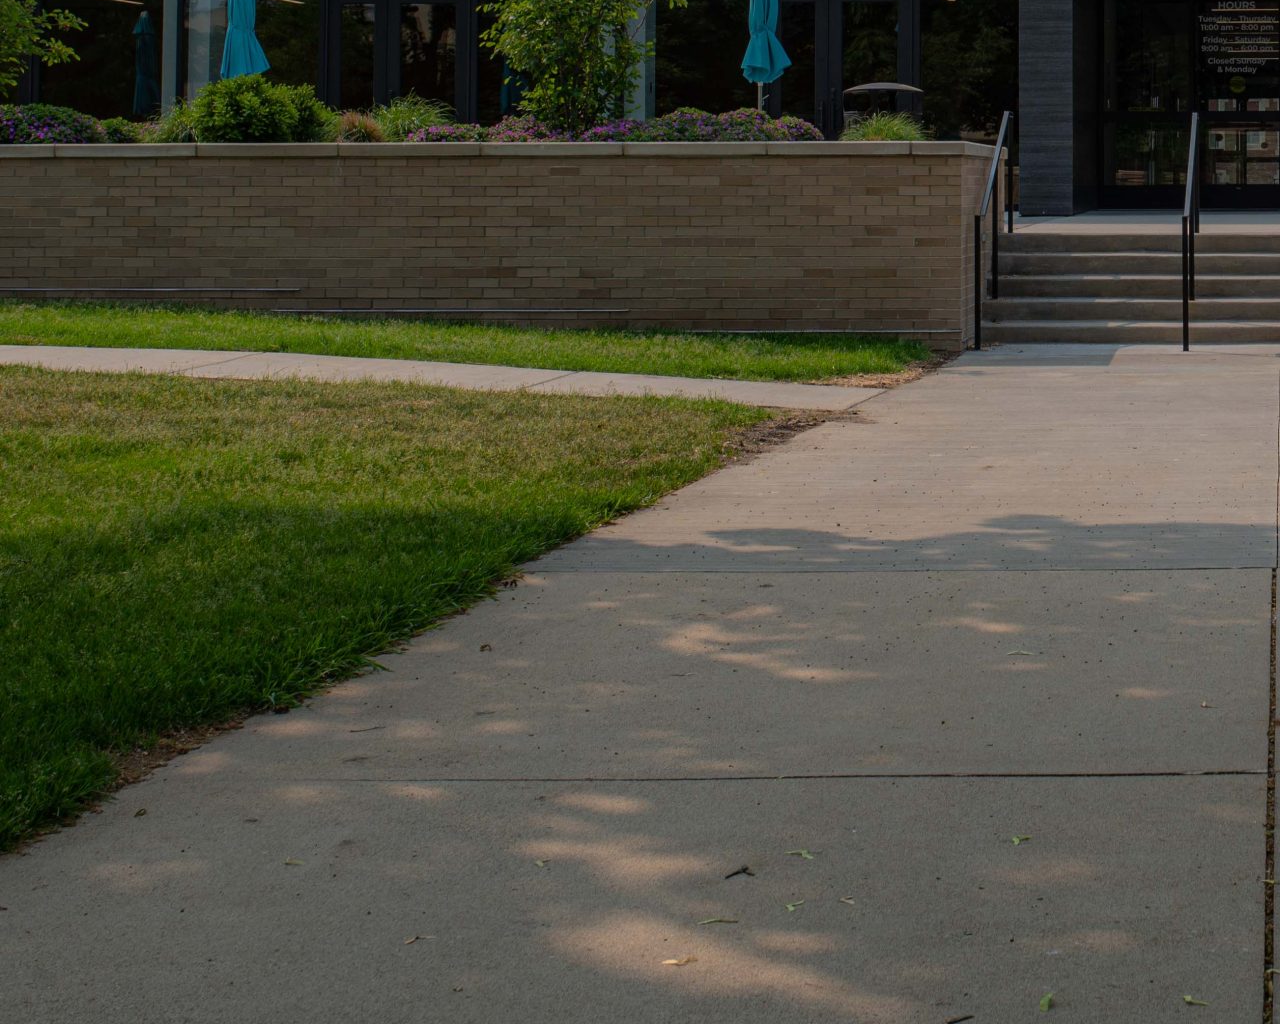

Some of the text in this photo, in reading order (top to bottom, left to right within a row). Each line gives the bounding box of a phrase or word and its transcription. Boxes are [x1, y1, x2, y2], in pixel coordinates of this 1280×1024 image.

[1218, 1, 1256, 9] HOURS
[1198, 15, 1232, 23] Tuesday
[1239, 15, 1276, 23] Thursday
[1203, 36, 1227, 44] Friday
[1225, 66, 1257, 74] Monday
